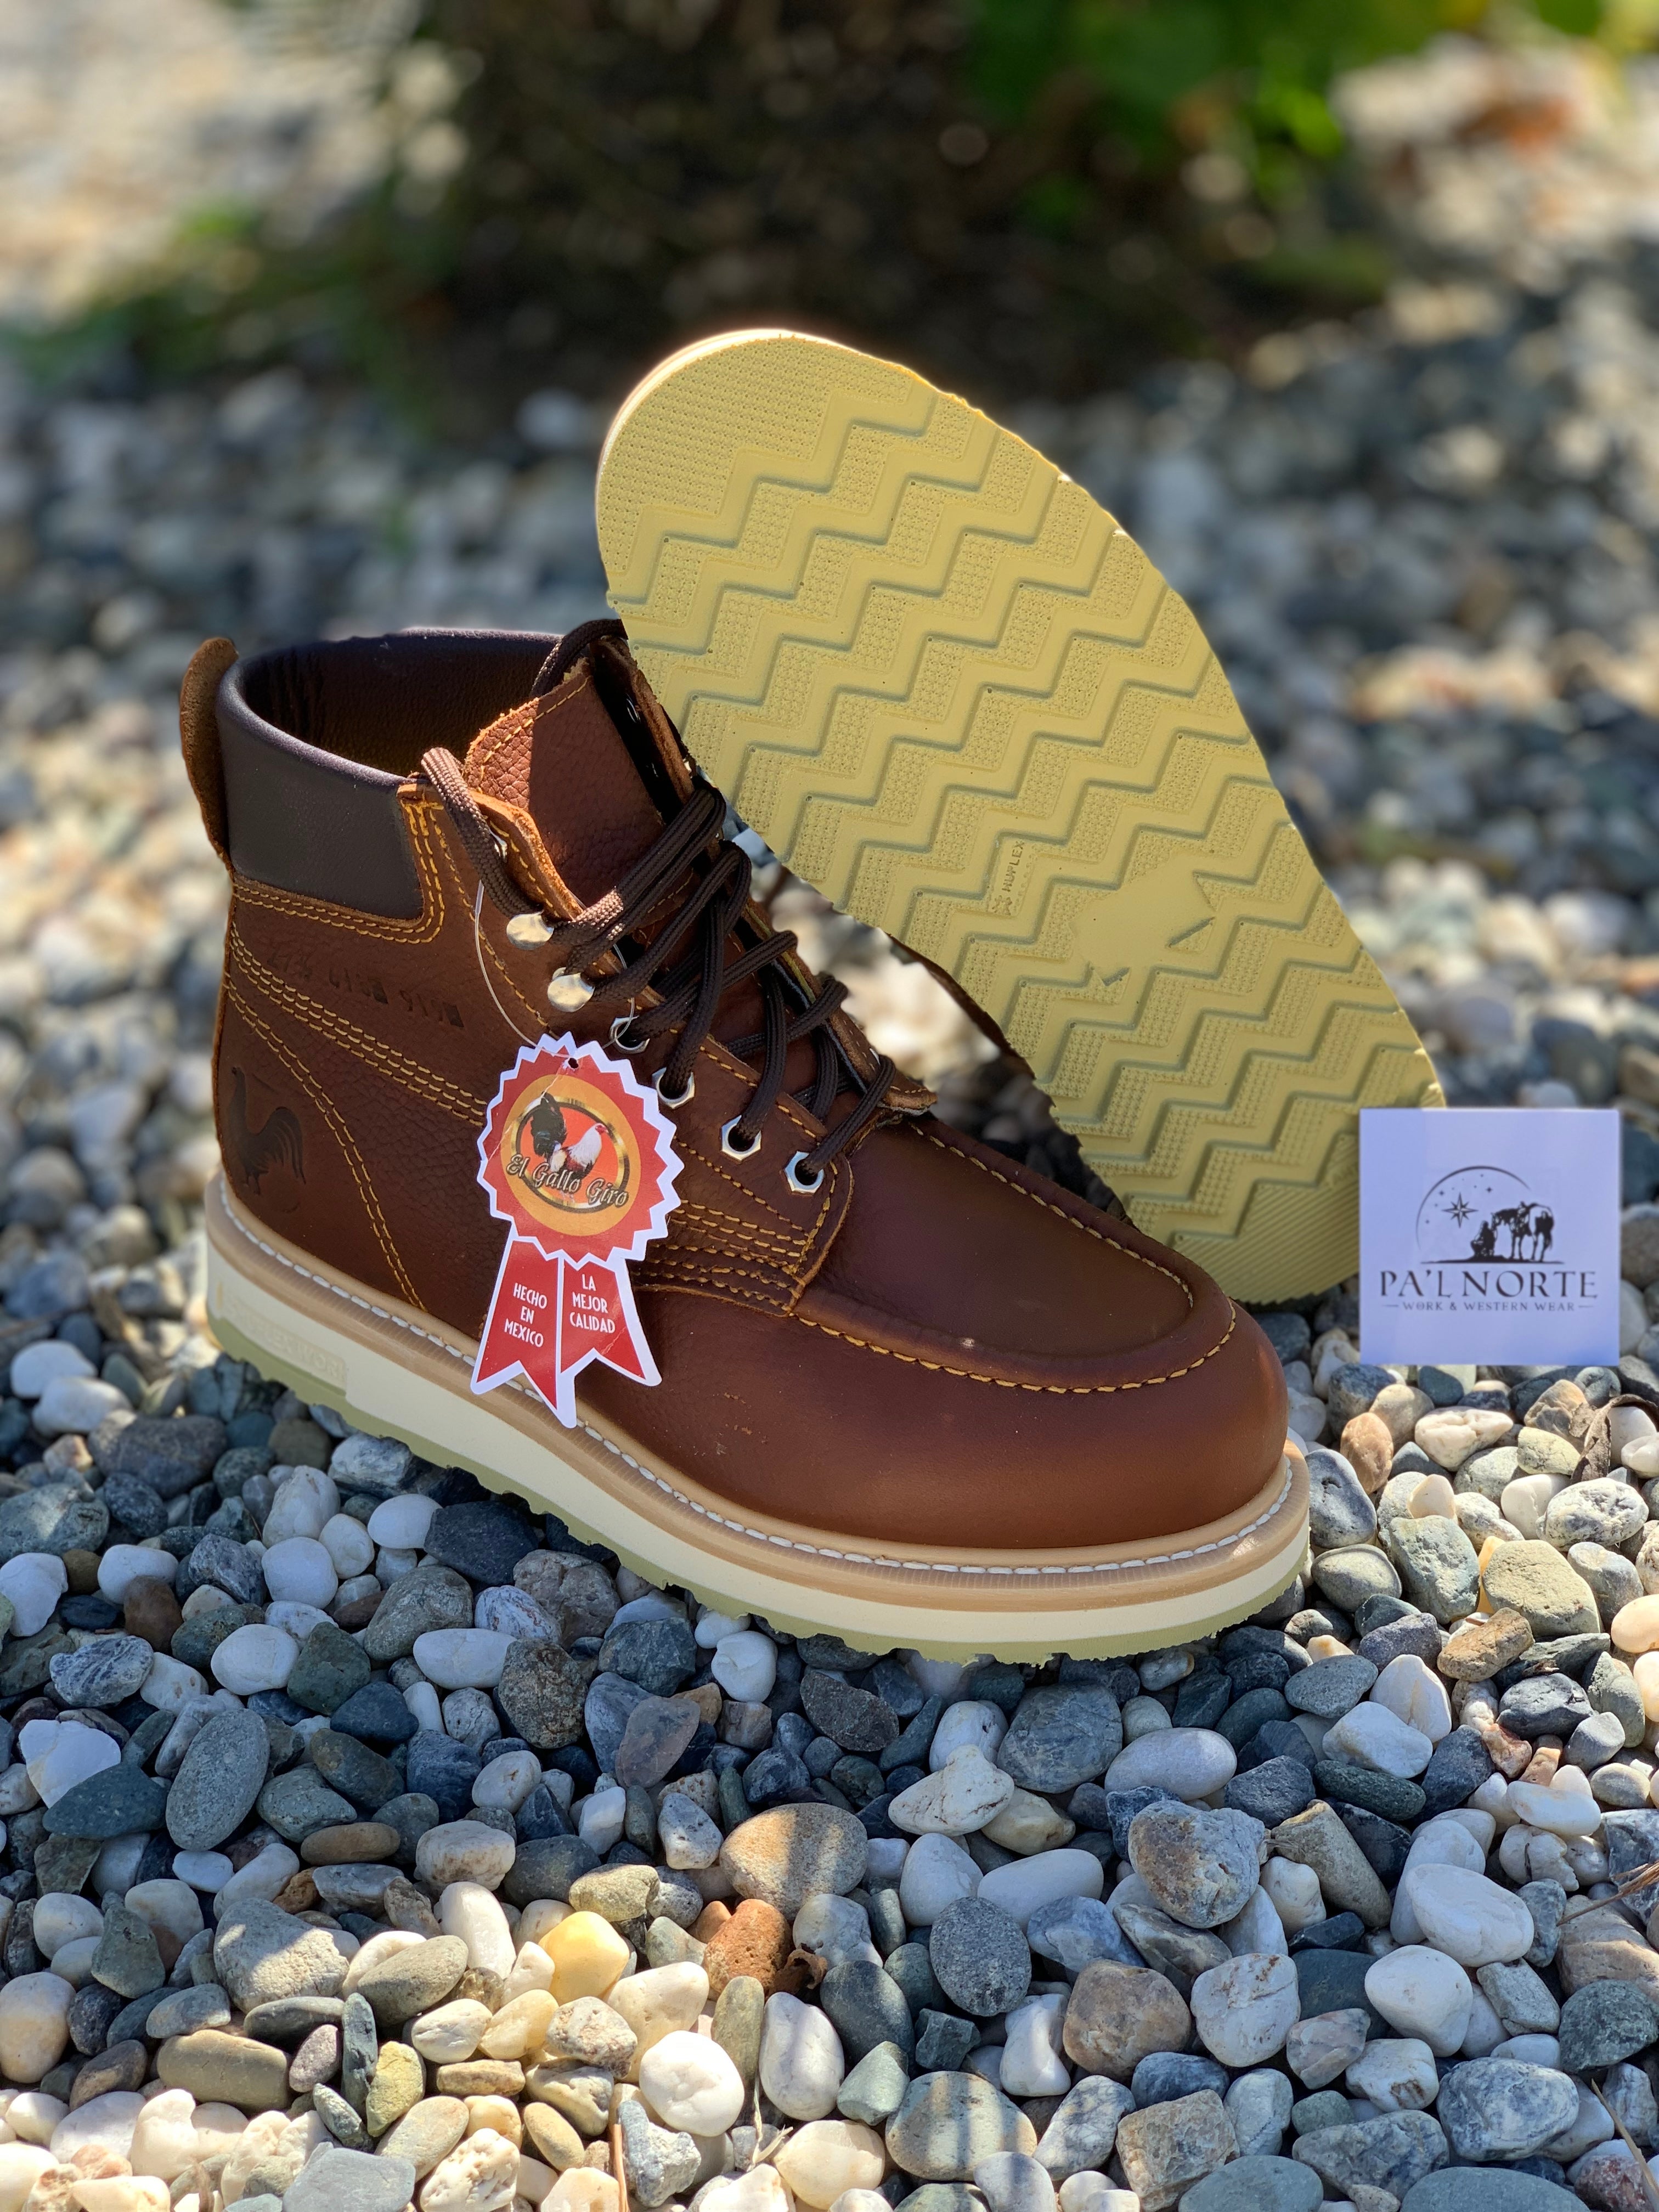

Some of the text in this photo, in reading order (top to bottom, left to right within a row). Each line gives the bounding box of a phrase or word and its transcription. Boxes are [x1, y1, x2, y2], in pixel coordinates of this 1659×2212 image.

[506, 1154, 629, 1207] El Gallo Giro
[582, 1274, 596, 1291] LA
[1462, 1270, 1598, 1299] NORTE
[512, 1283, 548, 1309] HECHO
[572, 1291, 608, 1314] MEJOR
[1402, 1301, 1575, 1312] WORK & WESTERN WEAR
[521, 1306, 535, 1324] EN
[569, 1312, 615, 1334] CALIDAD
[504, 1318, 544, 1347] MEXICO
